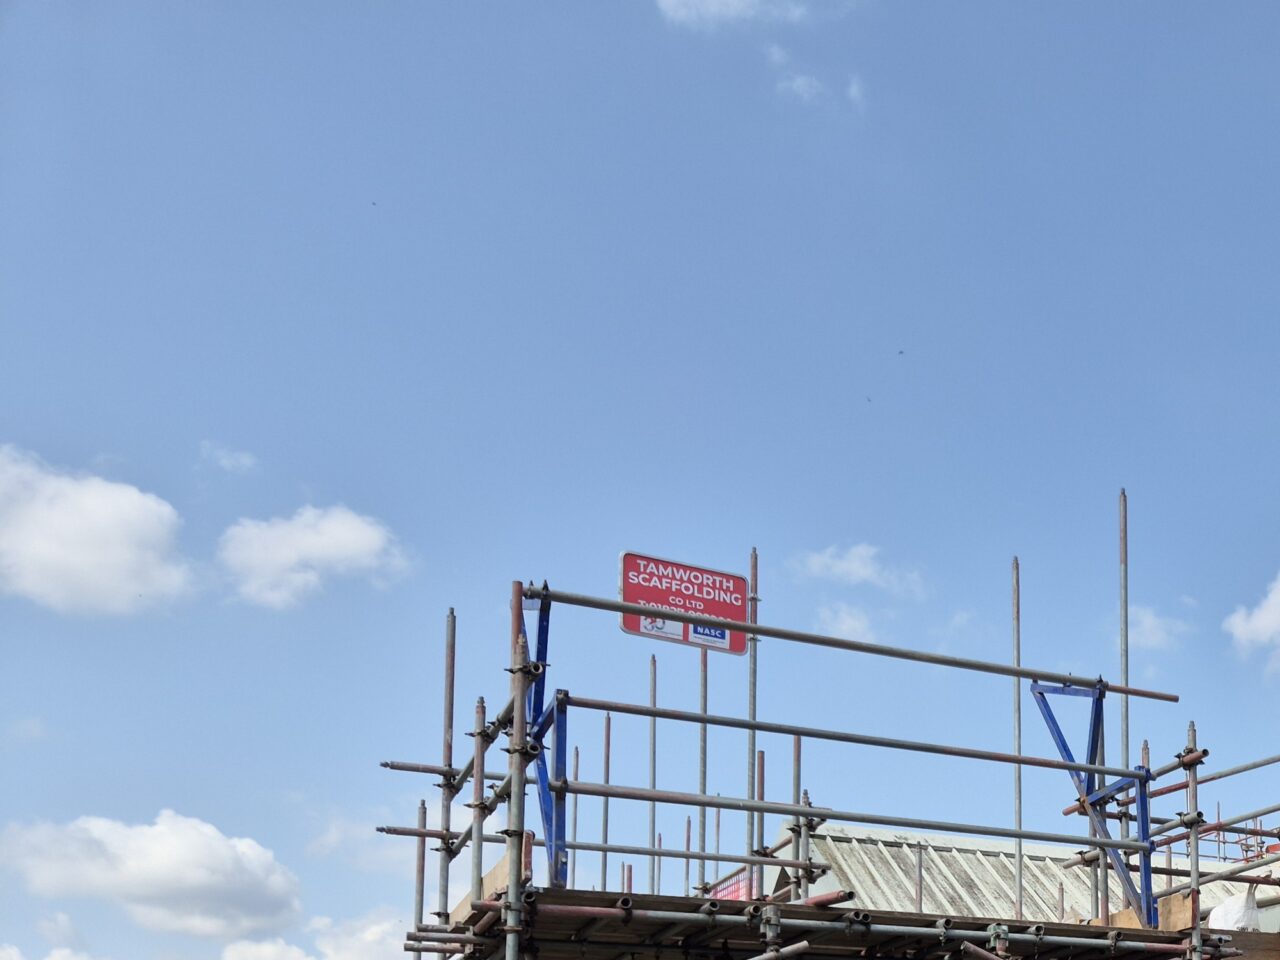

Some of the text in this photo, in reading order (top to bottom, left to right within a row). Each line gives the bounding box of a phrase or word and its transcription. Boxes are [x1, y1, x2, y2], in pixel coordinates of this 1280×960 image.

[637, 560, 734, 591] TAMWORTH
[628, 571, 742, 606] SCAFFOLDING
[669, 596, 704, 610] CO LTD
[697, 626, 722, 638] NASC
